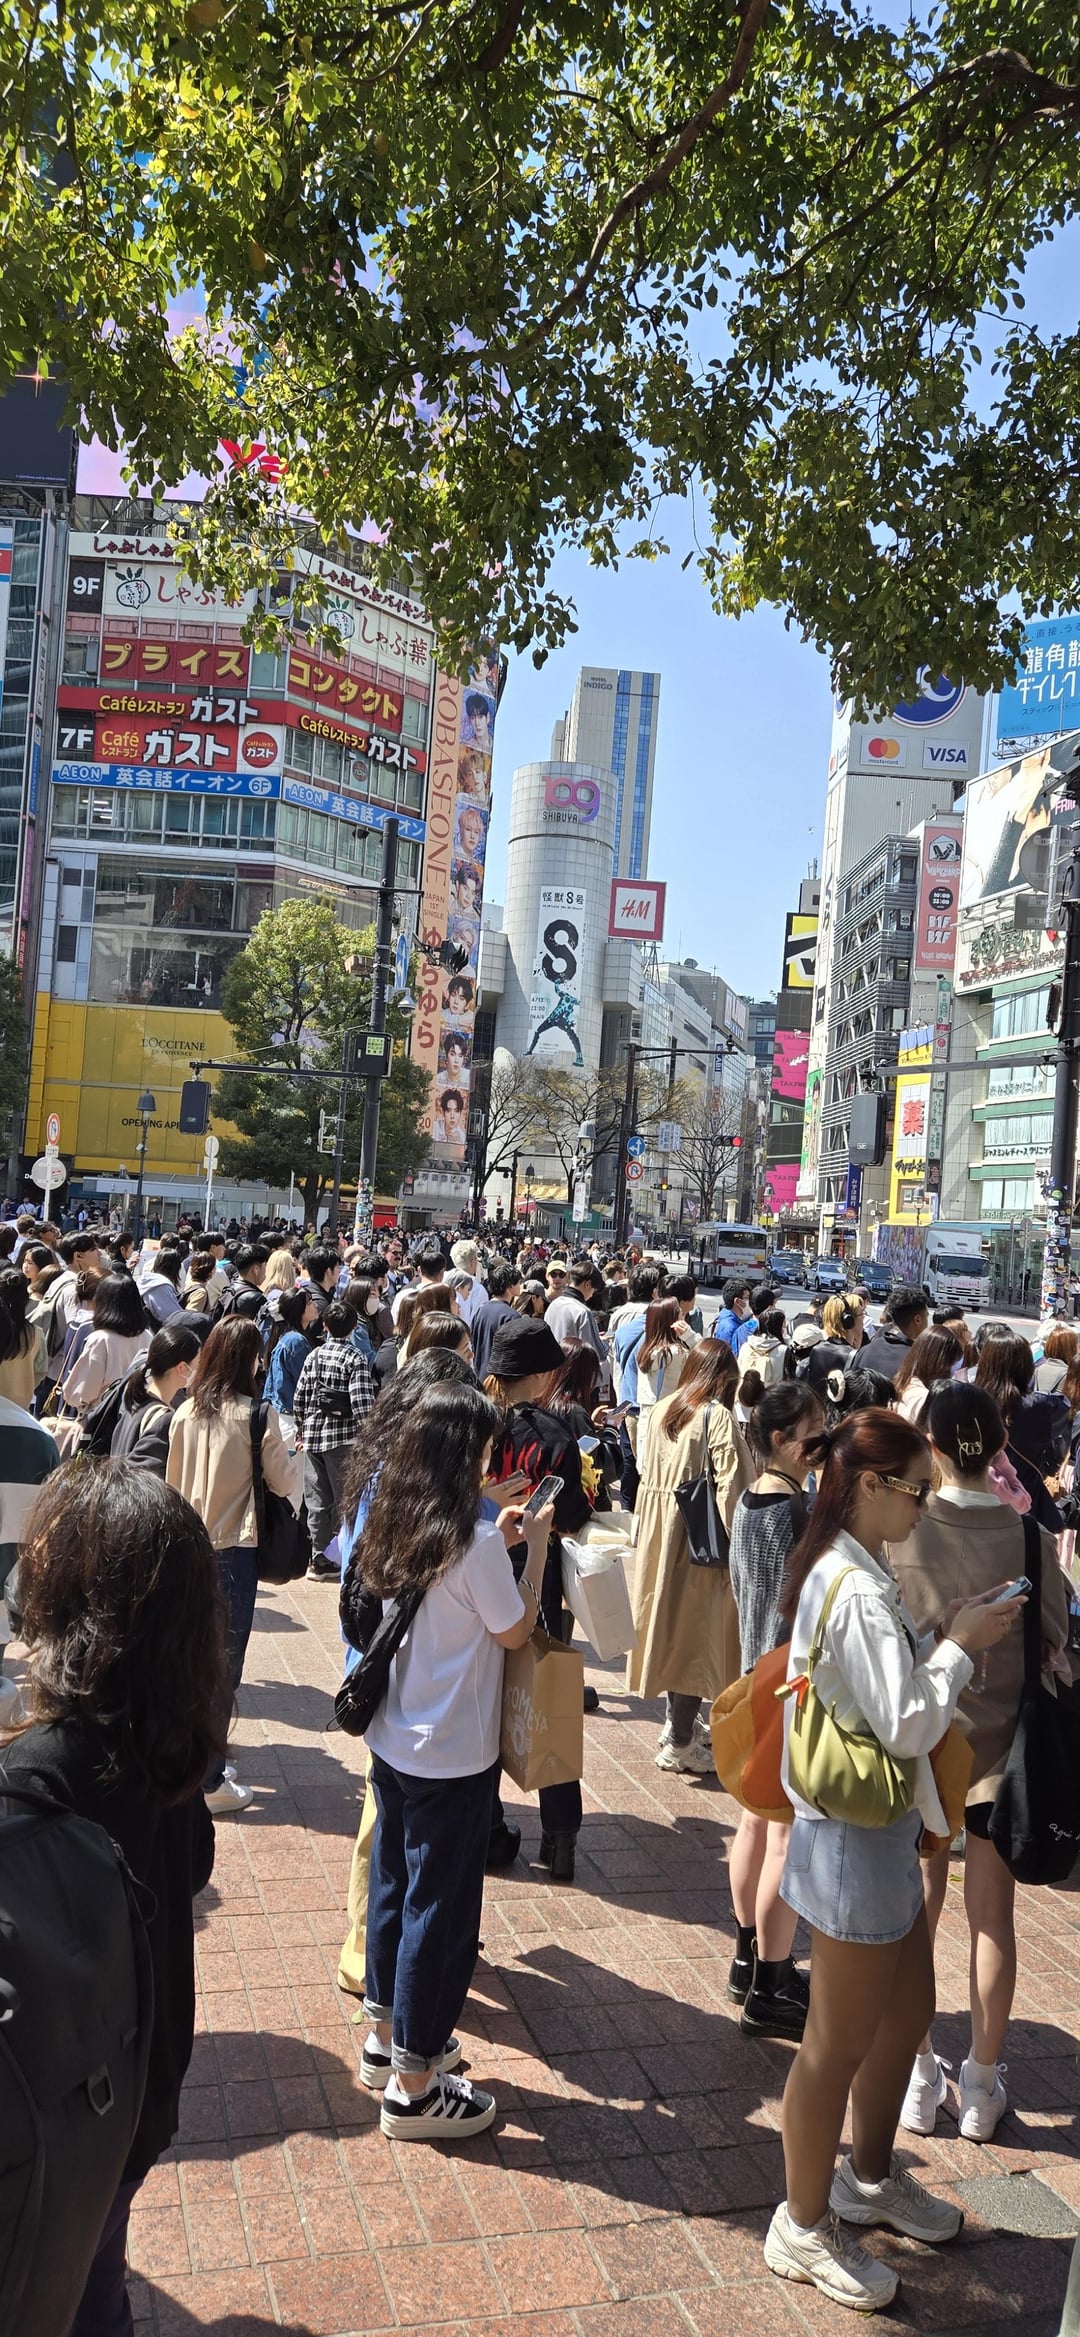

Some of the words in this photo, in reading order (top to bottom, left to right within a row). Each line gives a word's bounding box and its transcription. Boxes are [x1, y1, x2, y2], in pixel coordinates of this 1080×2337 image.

[93, 536, 174, 557] しゃぶしゃぶ
[73, 577, 99, 595] 9F
[361, 615, 428, 666] しゃぶ葉
[104, 645, 246, 679] プライス
[289, 657, 399, 720] コンタクト
[583, 681, 613, 690] INDIGO
[190, 697, 259, 725] ガスト
[61, 728, 94, 749] 7F
[101, 730, 139, 748] Café
[143, 729, 230, 766] ガスト
[102, 747, 138, 758] レストラン
[246, 748, 274, 758] ガスト
[367, 736, 417, 770] ガスト
[927, 747, 967, 763] VISA
[60, 766, 101, 779] AEON
[116, 768, 242, 792] 英会話イーオン
[252, 780, 269, 793] 6F
[426, 673, 460, 887] ROBASEONE
[290, 784, 323, 804] AEON
[541, 775, 601, 823] 109
[331, 796, 423, 836] 英会話イオン
[542, 811, 578, 823] SHIBUYA
[425, 892, 445, 903] JAPAN
[423, 909, 444, 920] SINGLE
[621, 899, 651, 919] H&M
[928, 915, 952, 928] B1F
[927, 930, 951, 944] B2F
[142, 1037, 206, 1051] L'OCCITANE
[902, 1100, 925, 1137] 薬
